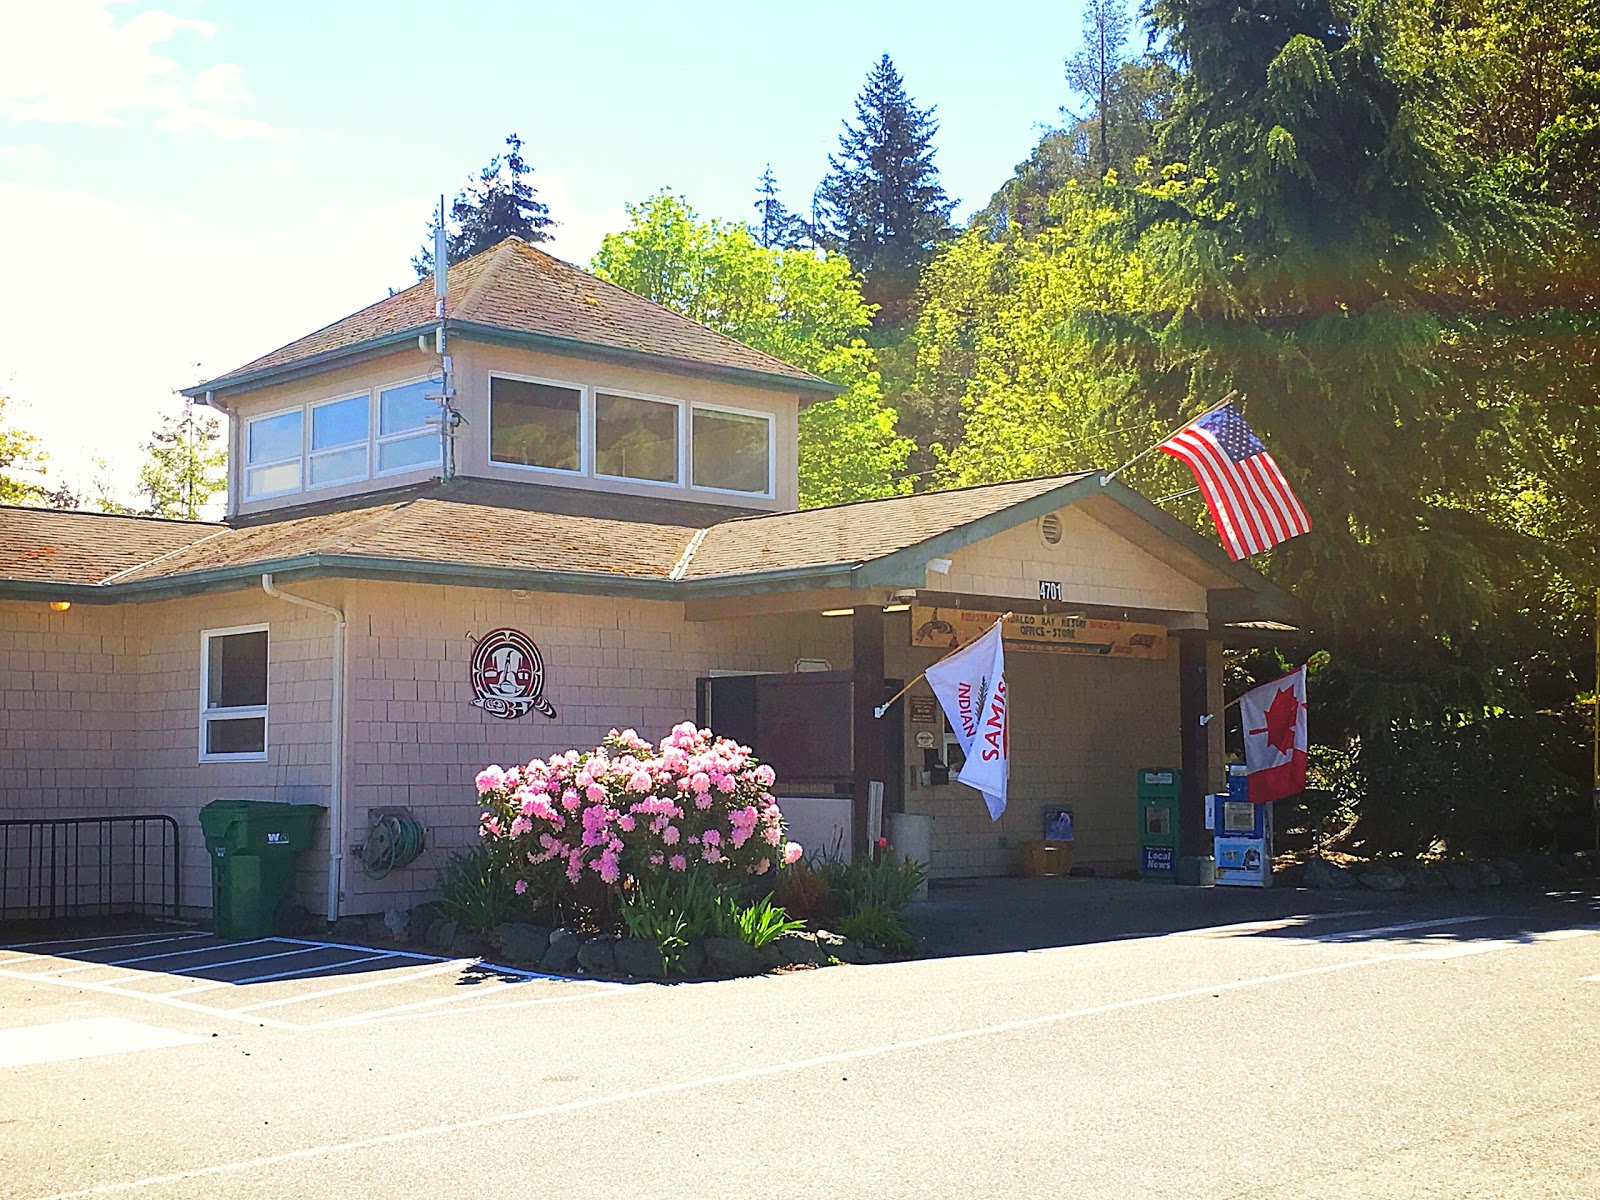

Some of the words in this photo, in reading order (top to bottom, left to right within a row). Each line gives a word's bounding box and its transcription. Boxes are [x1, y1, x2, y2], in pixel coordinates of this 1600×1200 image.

[1040, 581, 1061, 600] 4701
[957, 682, 976, 738] INDIAN
[1147, 851, 1171, 860] Local
[1147, 860, 1171, 869] News
